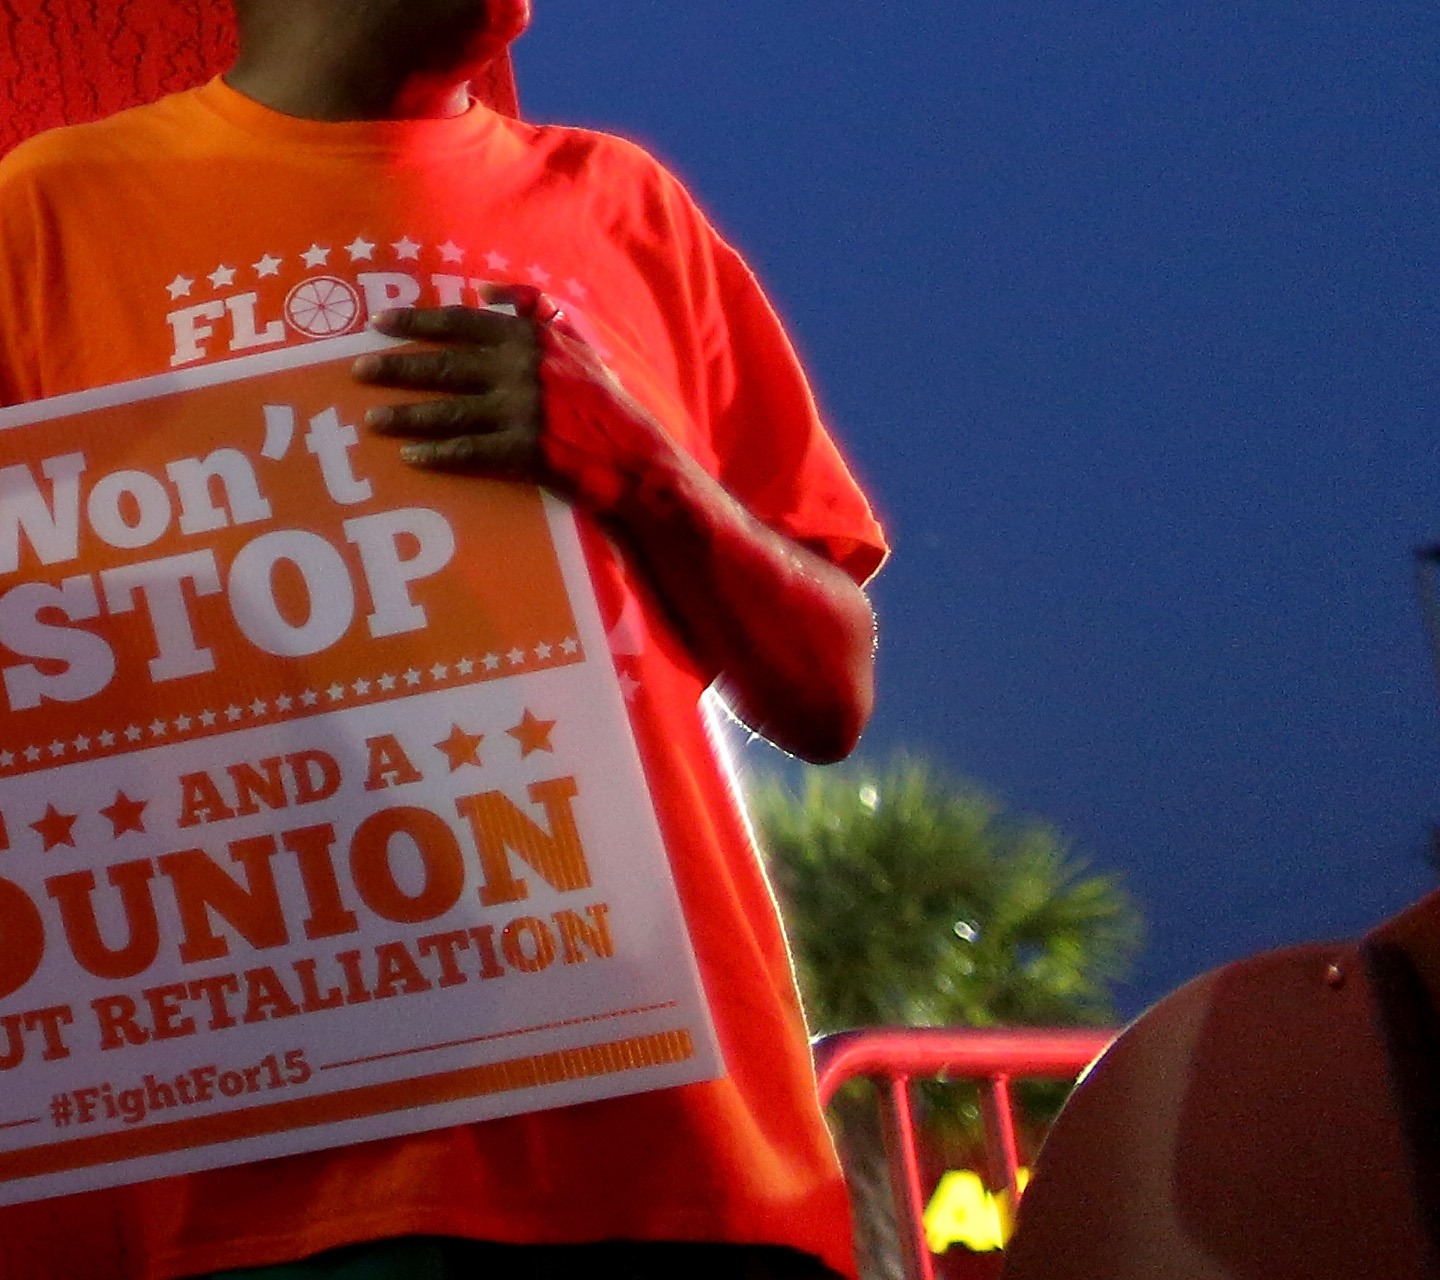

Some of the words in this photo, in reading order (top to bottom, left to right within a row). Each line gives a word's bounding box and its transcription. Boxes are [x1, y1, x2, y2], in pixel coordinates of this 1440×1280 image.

[176, 748, 343, 830] AND
[361, 732, 422, 791] A
[43, 776, 594, 982] UNION
[95, 903, 614, 1052] RETALIATION
[49, 1049, 314, 1129] #FightFor15
